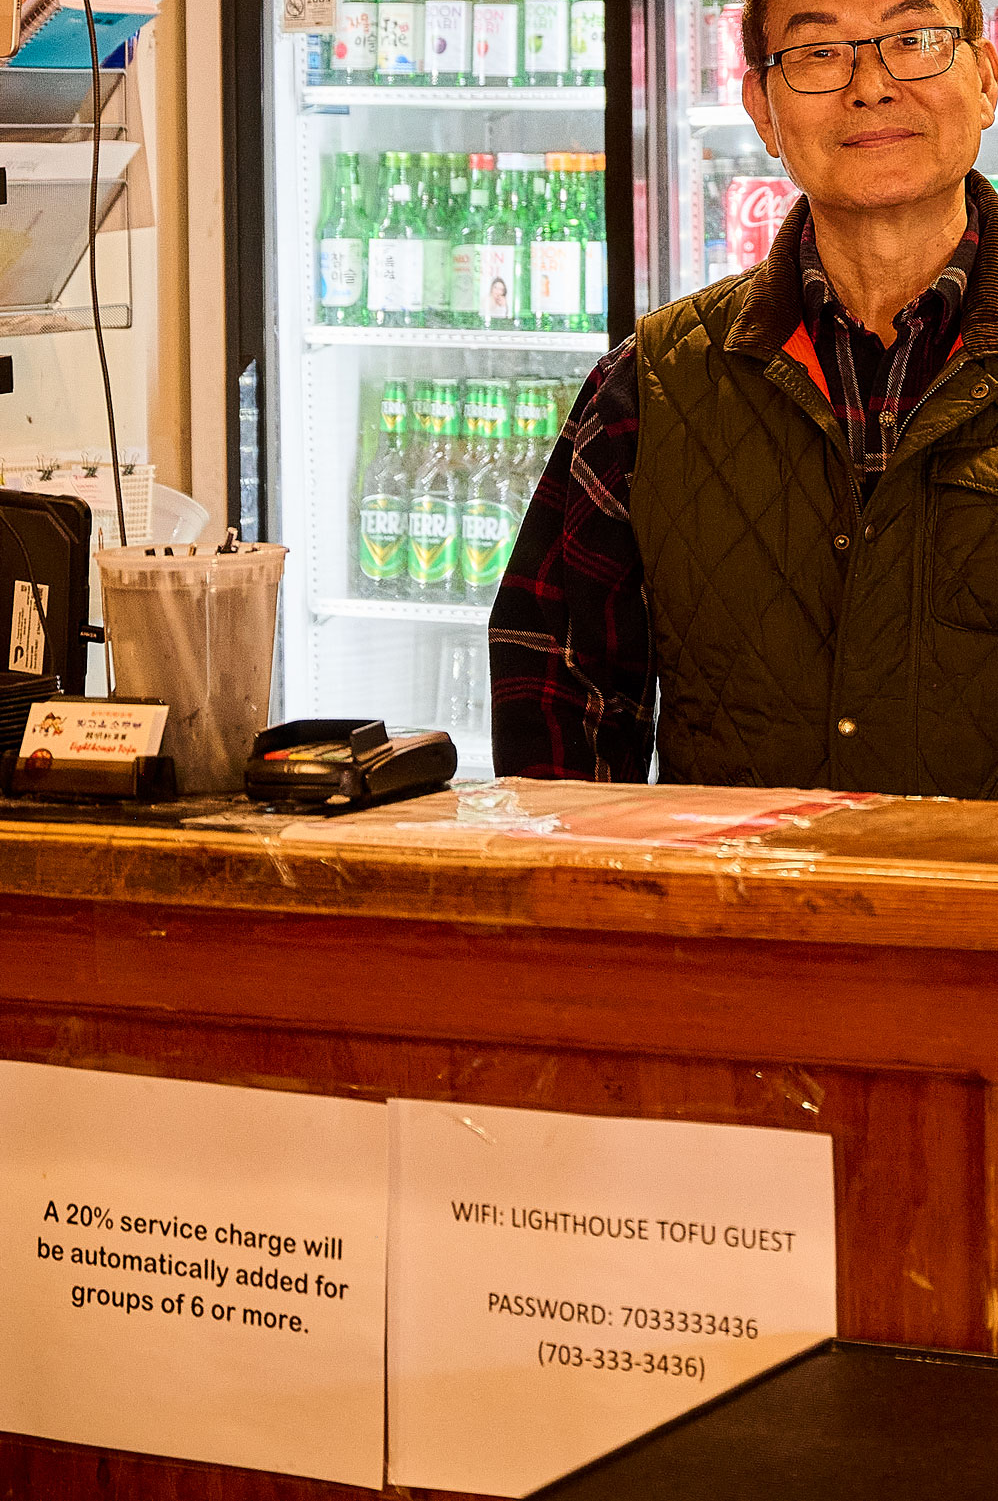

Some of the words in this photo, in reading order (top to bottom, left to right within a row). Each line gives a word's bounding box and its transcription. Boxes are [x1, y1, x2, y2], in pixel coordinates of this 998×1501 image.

[408, 512, 457, 538] TERRA
[462, 515, 511, 542] TERRA
[44, 1200, 59, 1223] A
[66, 1203, 114, 1230] 20%
[120, 1214, 207, 1241] service
[215, 1223, 296, 1257] charge
[304, 1237, 343, 1260] will
[451, 1201, 504, 1226] WIFI:
[512, 1207, 649, 1240] LIGHTHOUSE
[656, 1220, 716, 1245] TOFU
[724, 1226, 796, 1253] GUEST
[37, 1237, 64, 1260] be
[71, 1245, 229, 1287] automatically
[236, 1267, 308, 1295] added
[315, 1275, 349, 1300] for
[71, 1284, 154, 1314] groups
[161, 1294, 184, 1315] of
[191, 1296, 204, 1318] 6
[211, 1302, 236, 1322] or
[243, 1309, 309, 1334] more.
[488, 1292, 613, 1326] PASSWORD:
[621, 1307, 758, 1339] 7033333436
[538, 1340, 705, 1381] (703-333-3436)
